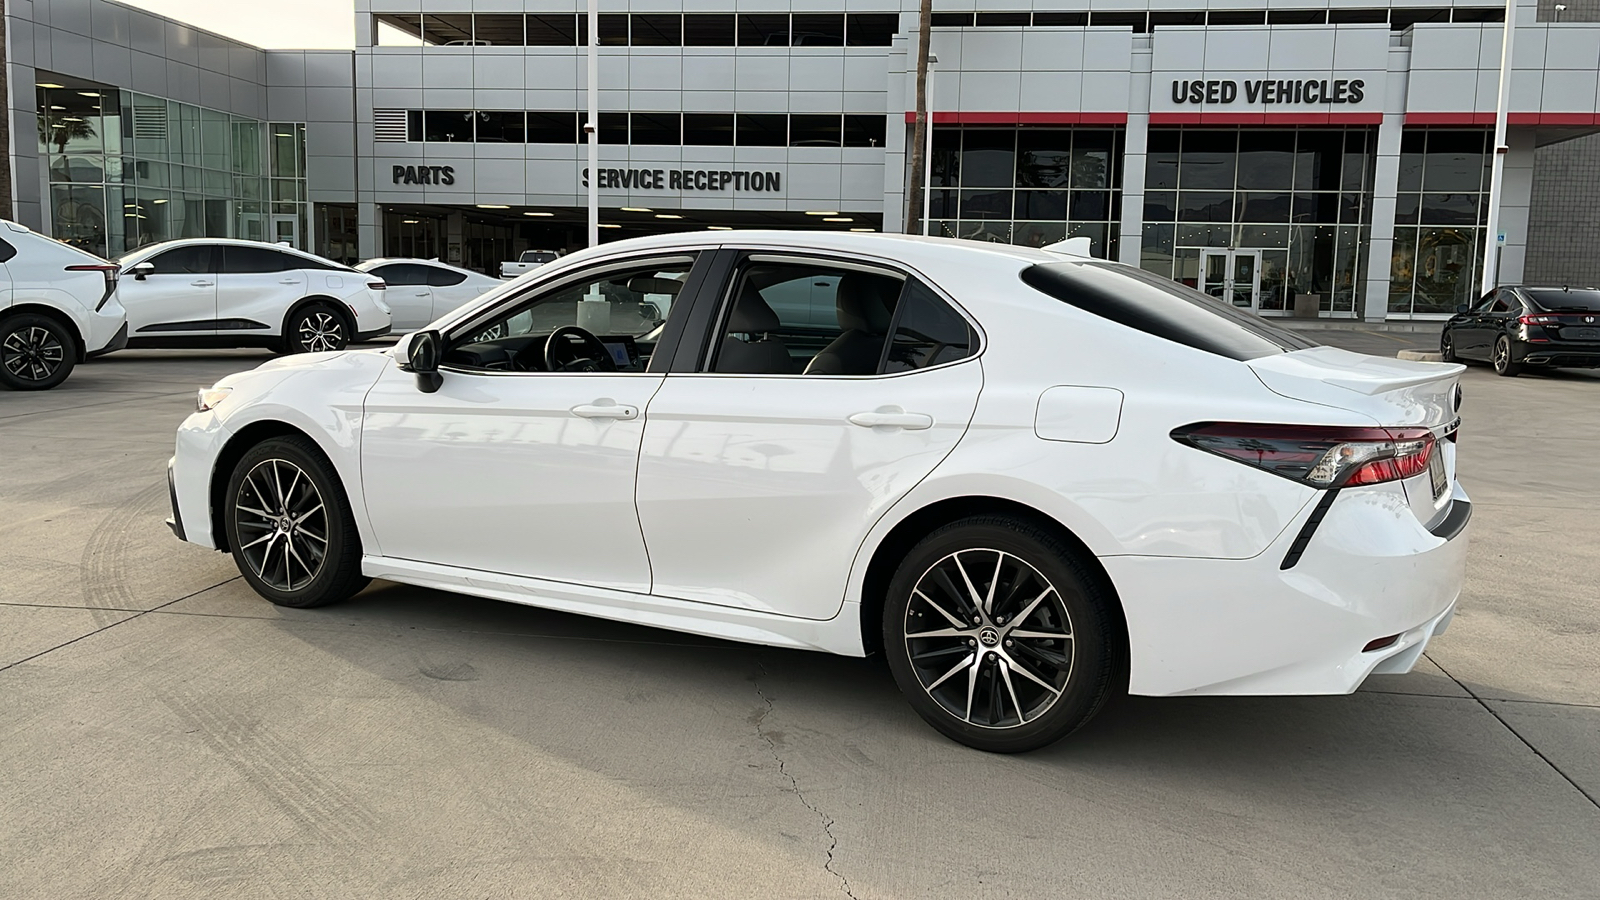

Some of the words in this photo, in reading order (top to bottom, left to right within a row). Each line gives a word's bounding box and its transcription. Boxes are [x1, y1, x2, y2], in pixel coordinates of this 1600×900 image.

[1172, 80, 1237, 104] USED
[1245, 80, 1365, 104] VEHICLES
[392, 165, 455, 185] PARTS
[669, 170, 781, 192] RECEPTION
